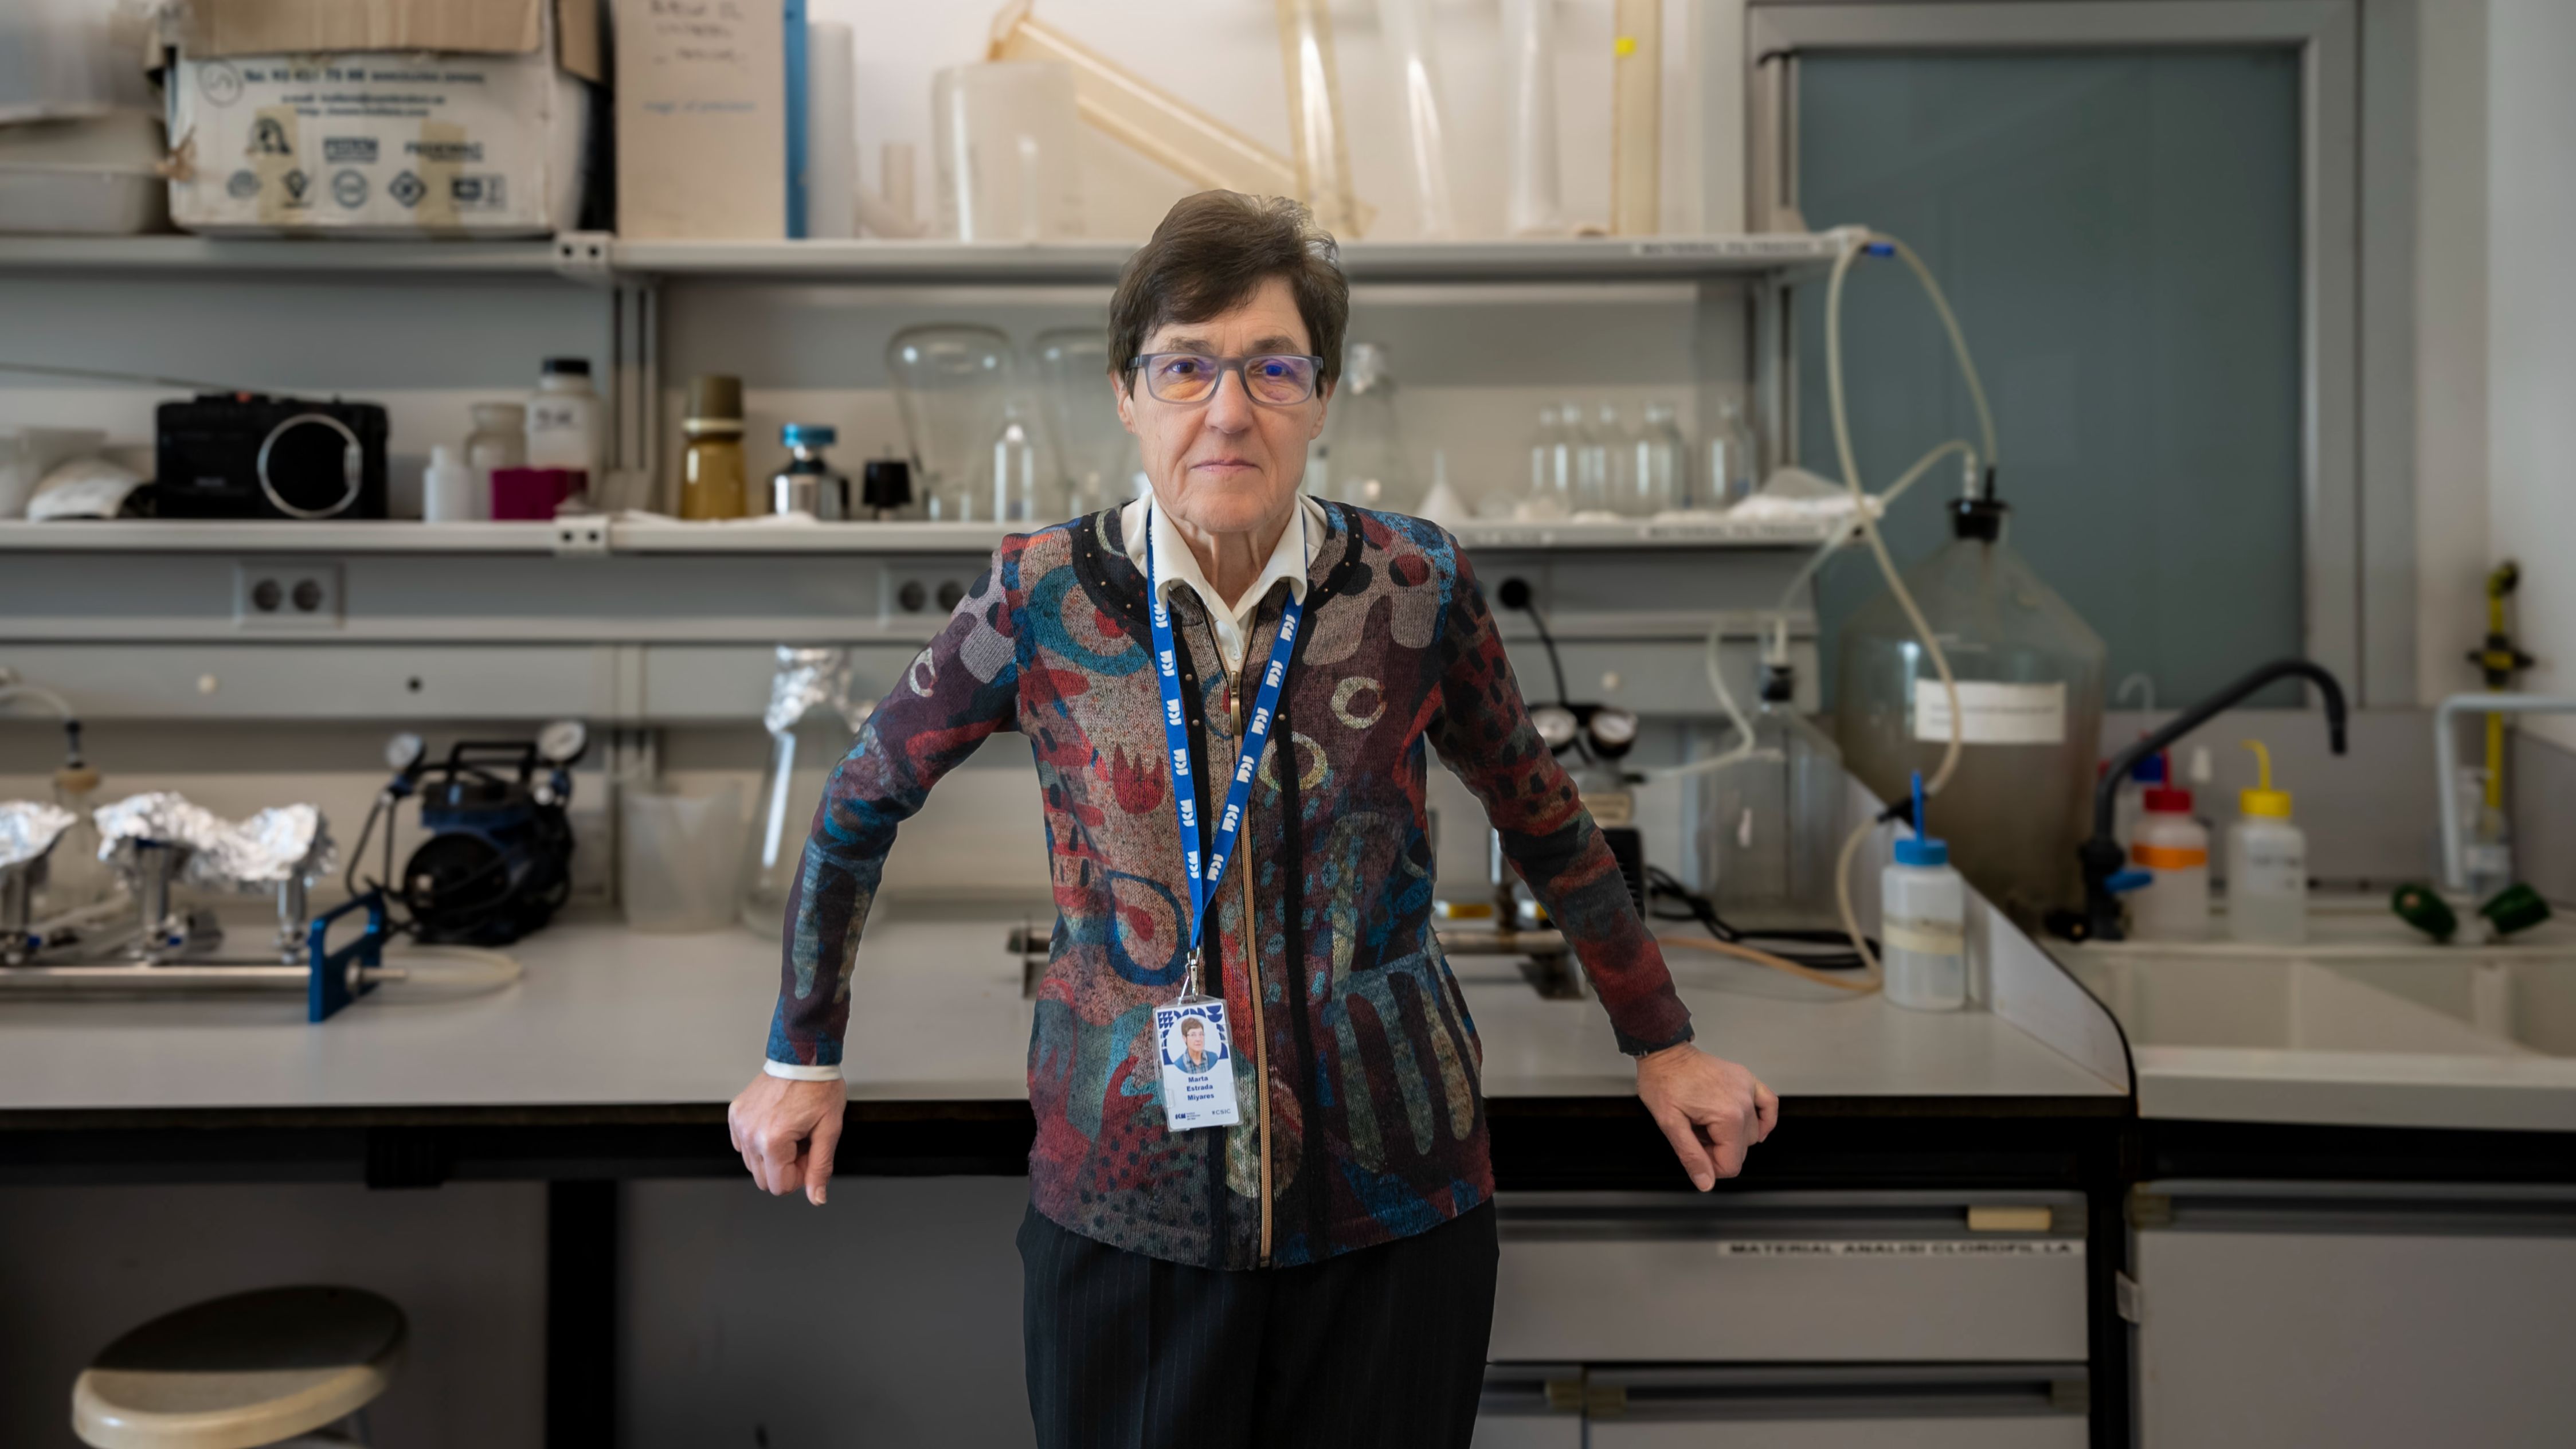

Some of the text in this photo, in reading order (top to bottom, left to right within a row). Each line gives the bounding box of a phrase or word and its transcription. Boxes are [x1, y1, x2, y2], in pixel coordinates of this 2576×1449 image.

[1280, 614, 1295, 641] ICM
[1160, 649, 1175, 677] ICM
[1266, 660, 1283, 688] ICM
[1166, 698, 1182, 726] ICM
[1251, 707, 1269, 735] ICM
[1173, 748, 1189, 776] ICM
[1236, 755, 1254, 783] ICM
[1180, 799, 1195, 827] ICM
[1222, 804, 1239, 832] ICM
[1187, 851, 1199, 879] ICM
[1207, 853, 1224, 881] ICM
[1729, 1243, 1831, 1254] MATERIAL
